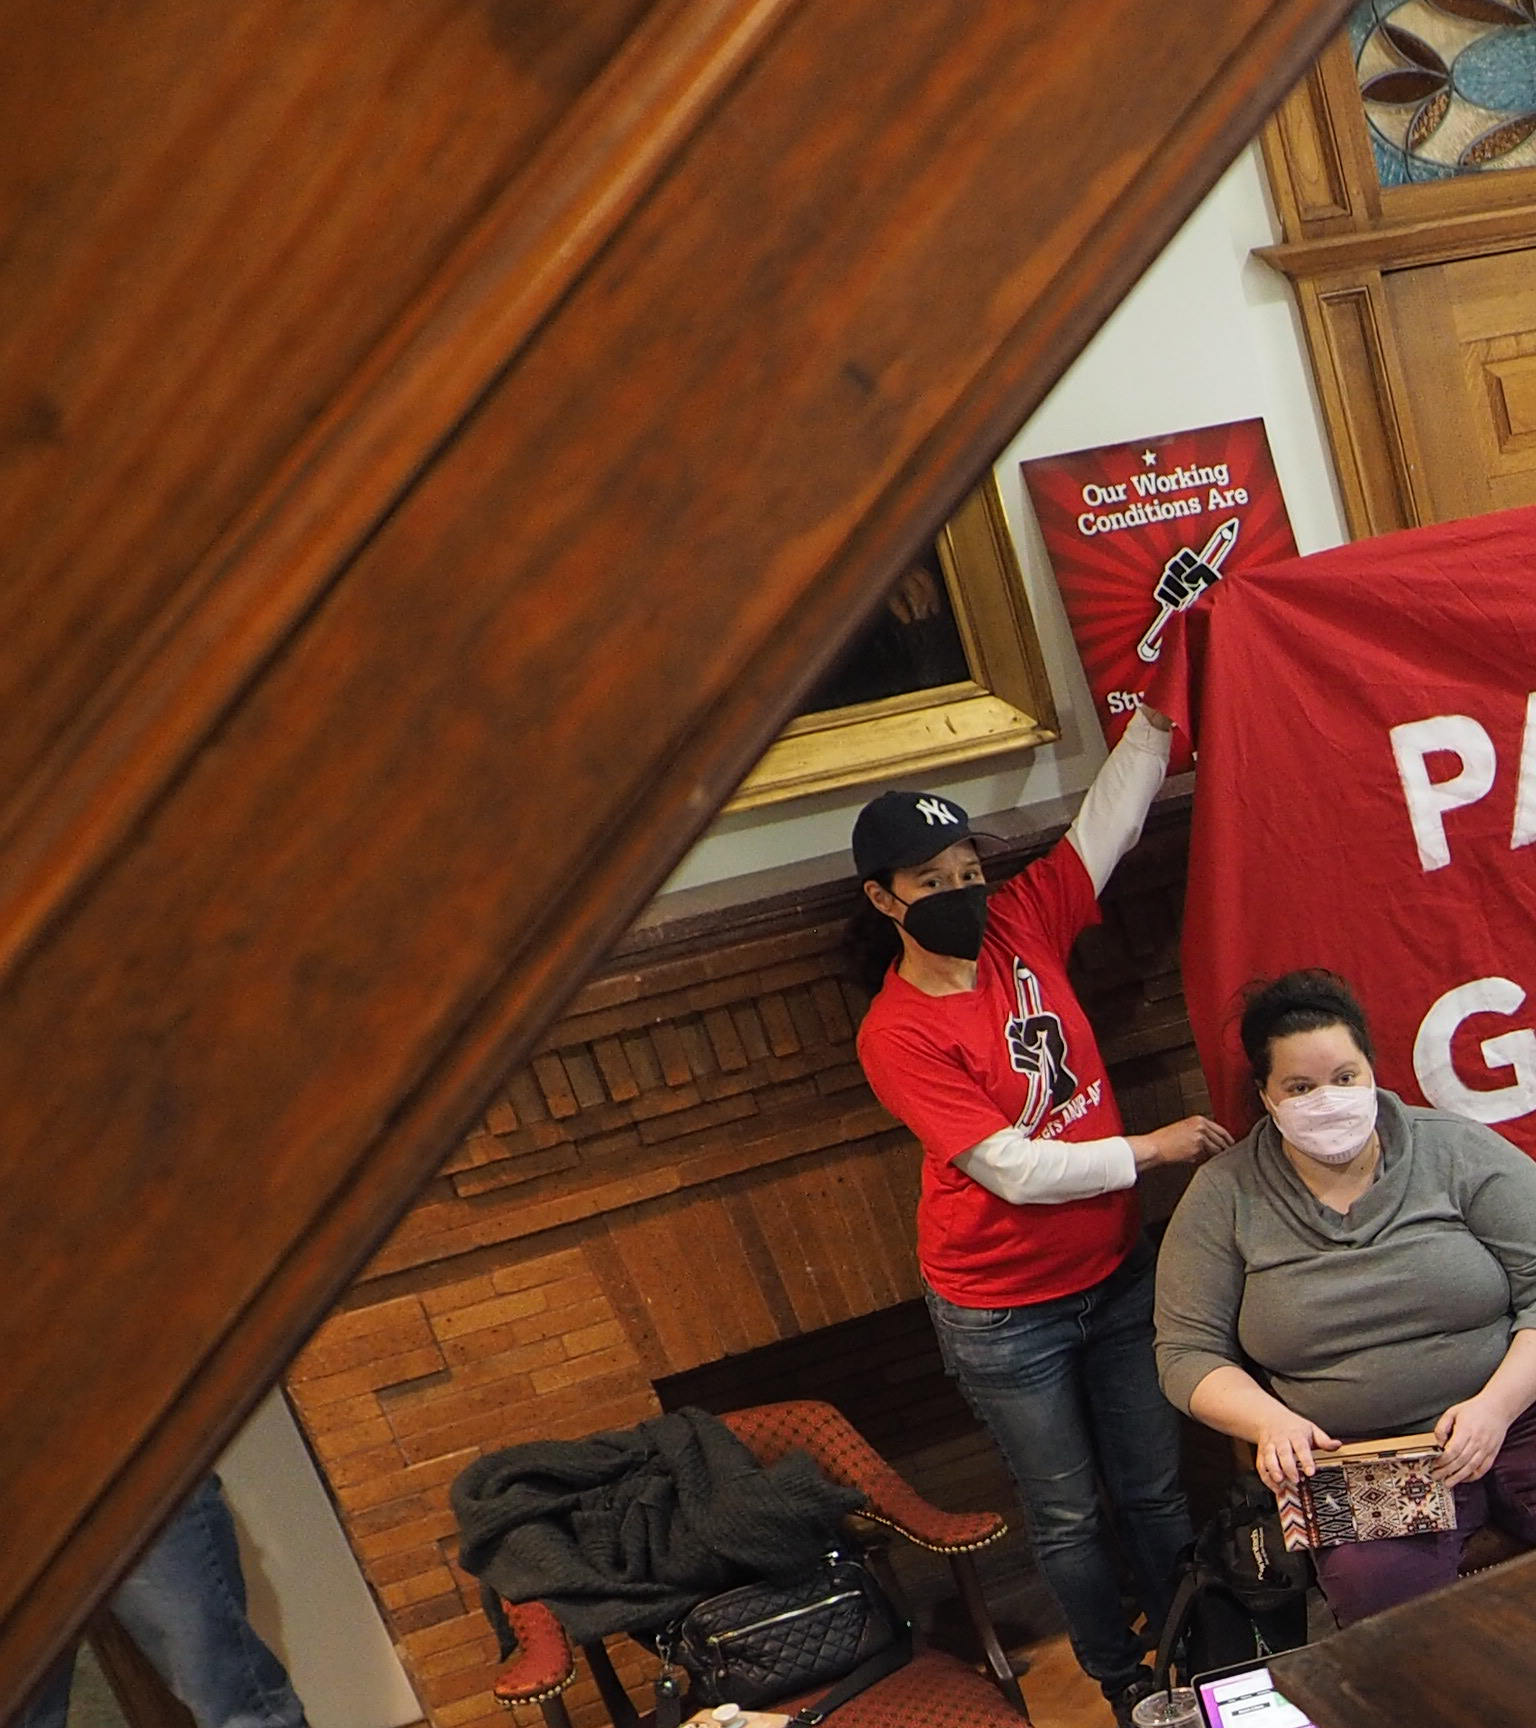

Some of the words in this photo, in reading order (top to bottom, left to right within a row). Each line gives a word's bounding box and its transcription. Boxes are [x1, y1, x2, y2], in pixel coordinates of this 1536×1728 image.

[1082, 480, 1128, 507] Our
[1131, 463, 1230, 498] Working
[1077, 494, 1202, 536] Conditions
[1208, 486, 1249, 512] Are
[916, 798, 959, 826] NY
